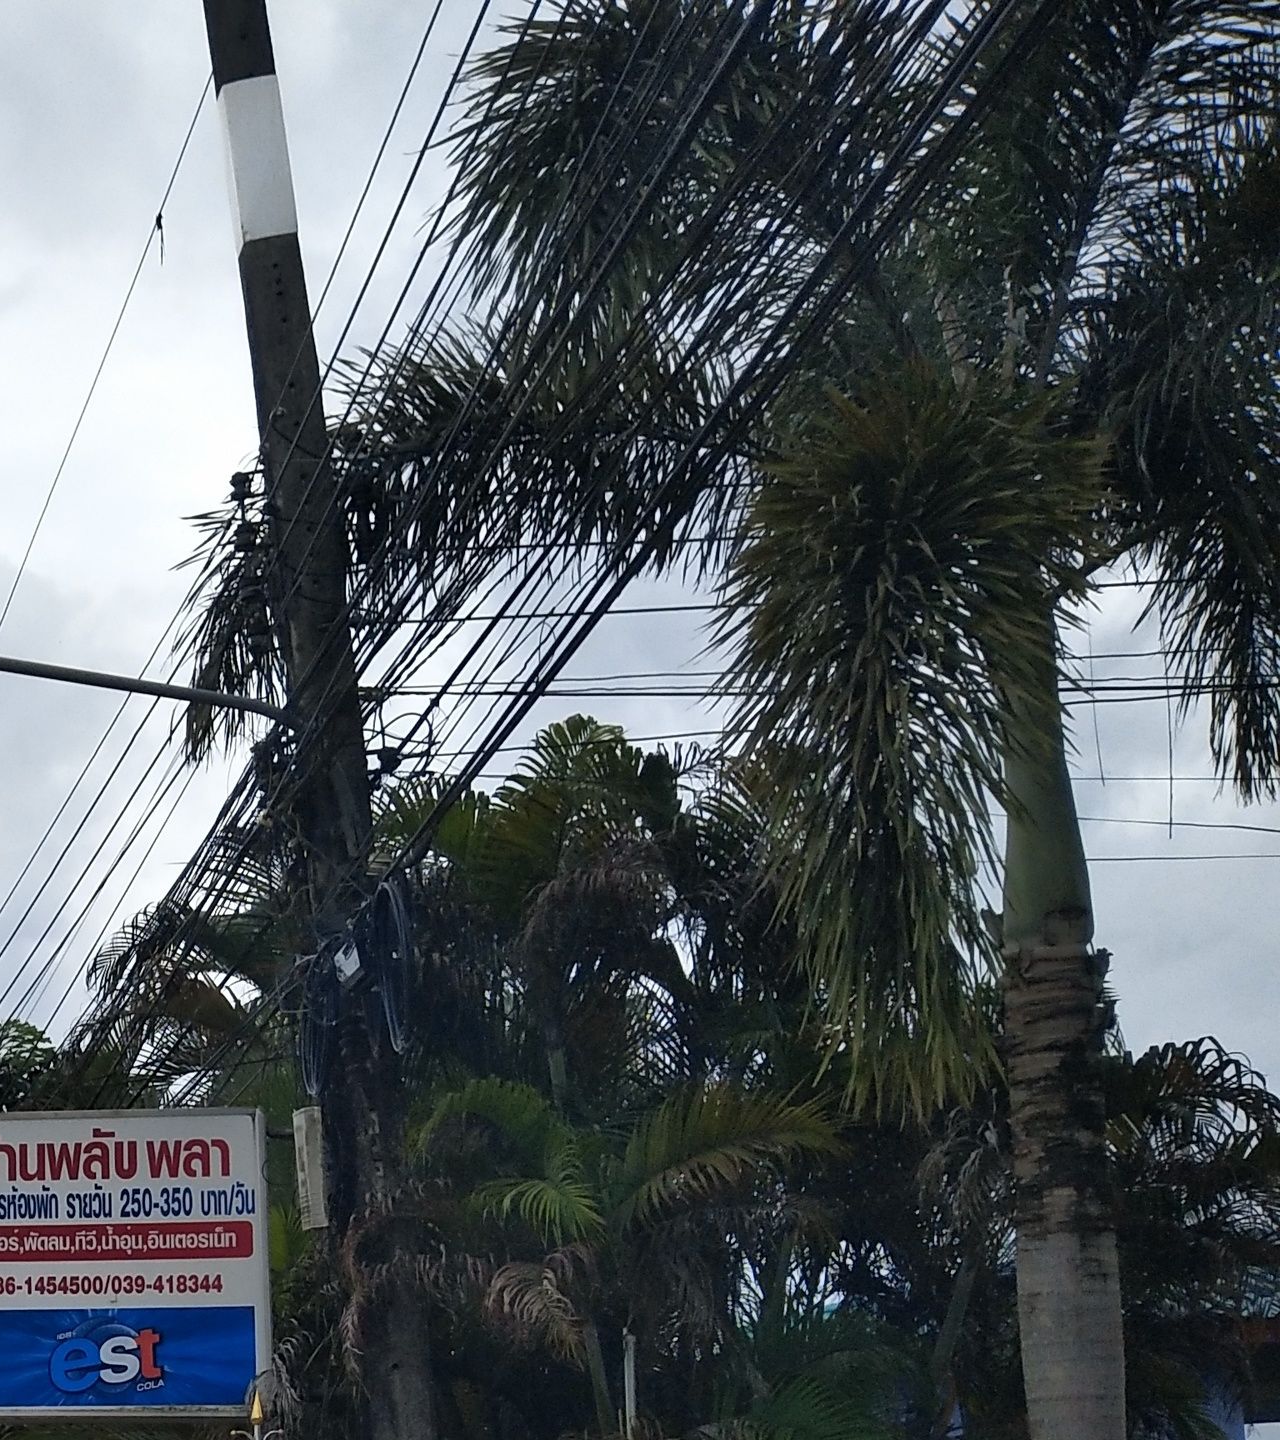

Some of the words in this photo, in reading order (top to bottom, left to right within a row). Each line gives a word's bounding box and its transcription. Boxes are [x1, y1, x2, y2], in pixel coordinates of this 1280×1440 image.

[146, 1137, 232, 1179] พลา
[66, 1183, 113, 1218] รายวัน
[119, 1187, 193, 1218] 250-350
[200, 1181, 256, 1216] บาท/วัน
[49, 1328, 162, 1392] est
[136, 1379, 166, 1392] COLA
